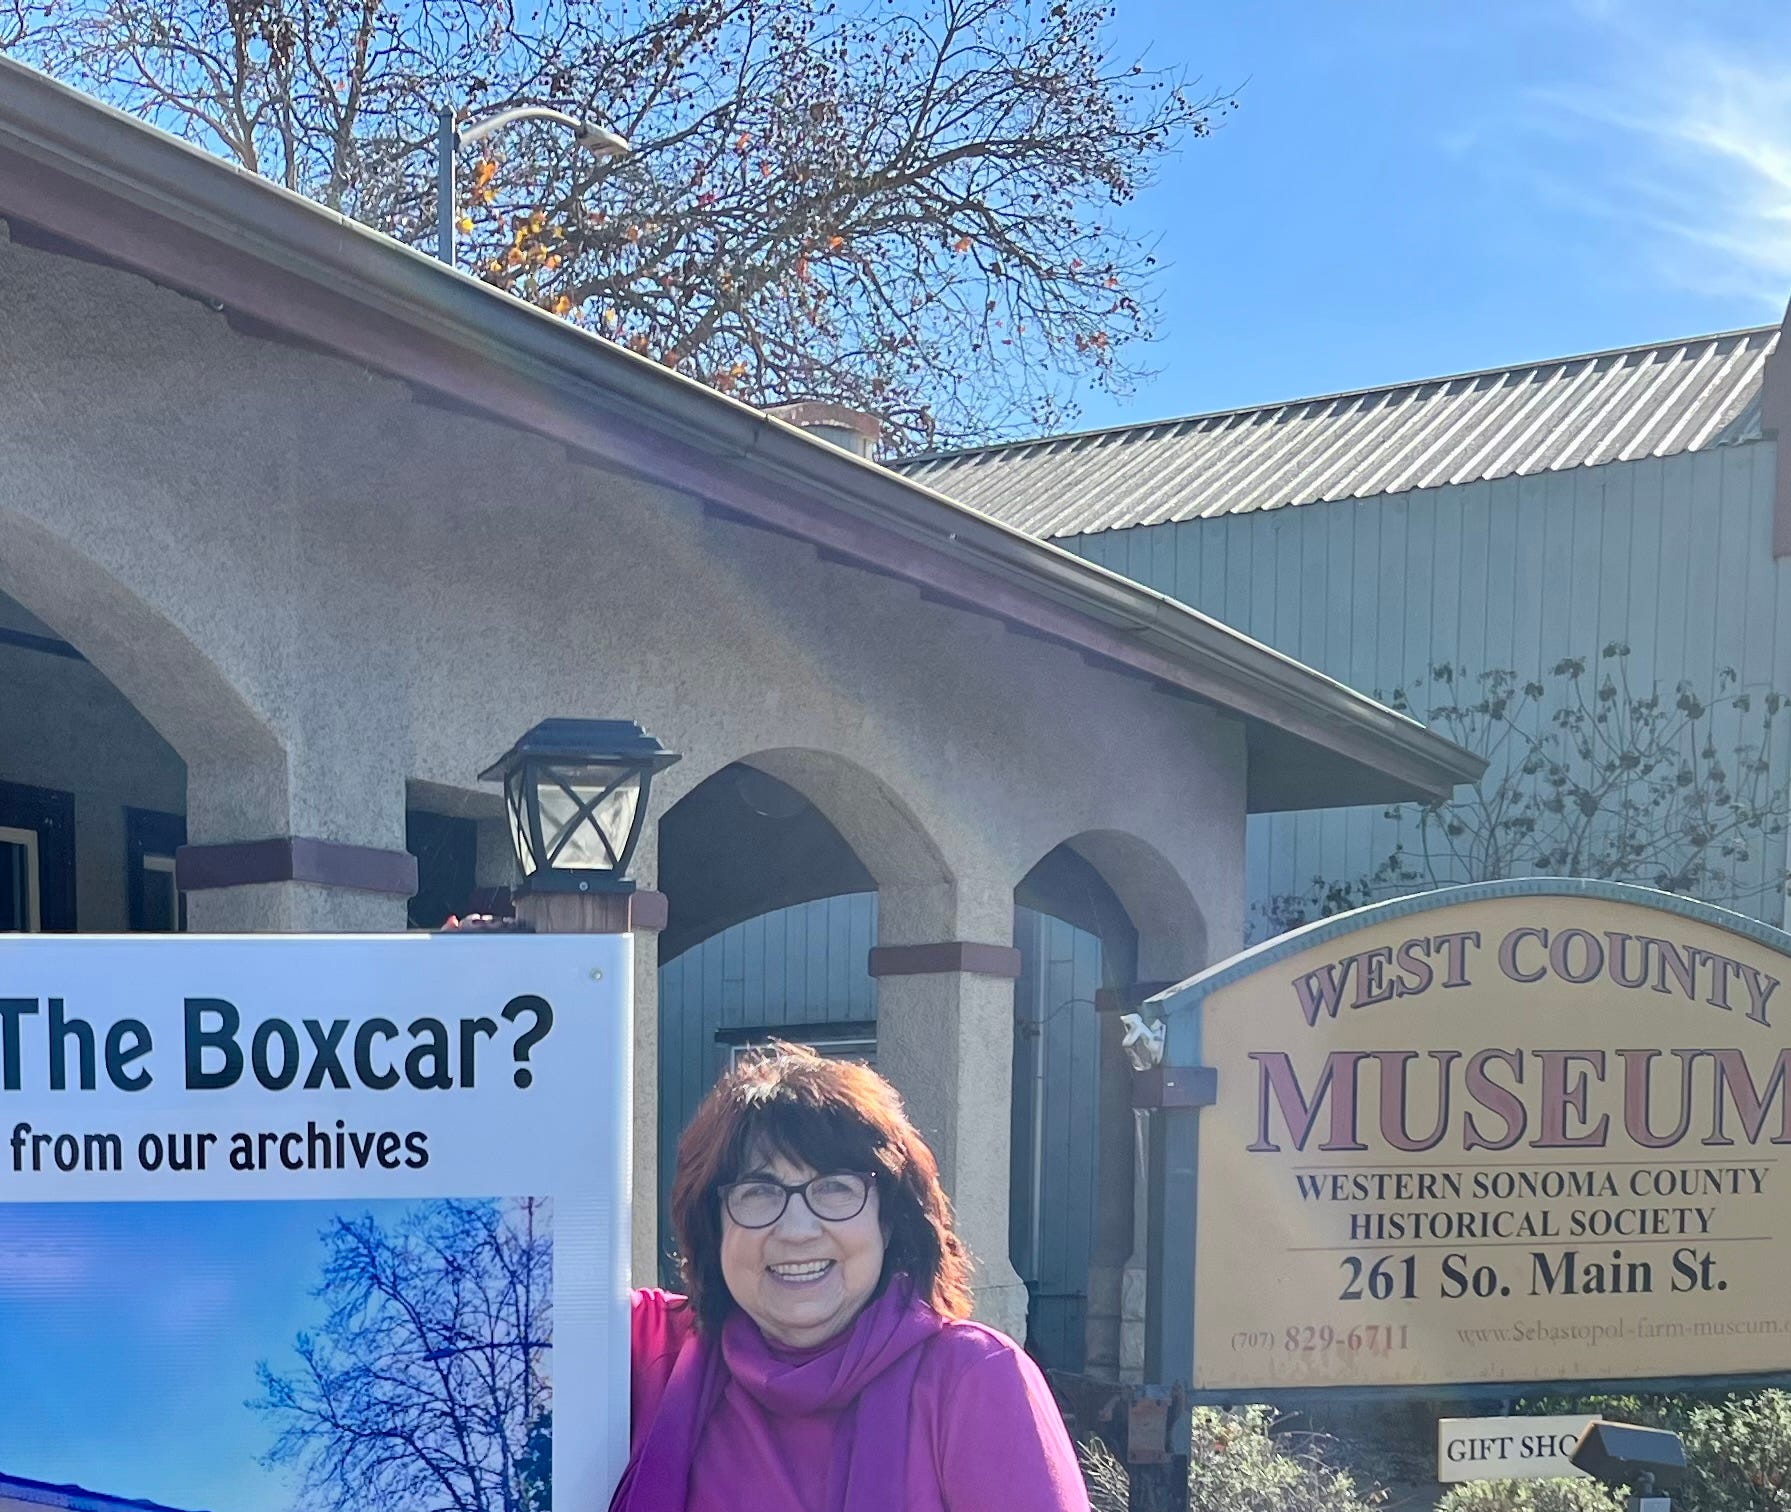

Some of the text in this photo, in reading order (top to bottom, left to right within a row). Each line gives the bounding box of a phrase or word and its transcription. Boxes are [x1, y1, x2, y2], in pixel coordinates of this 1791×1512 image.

[1291, 927, 1781, 1028] WEST COUNTY
[184, 994, 553, 1092] Boxcar?
[1246, 1046, 1791, 1153] MUSEUM
[10, 1122, 123, 1172] from
[139, 1133, 218, 1172] our
[230, 1119, 429, 1171] archives
[1295, 1167, 1770, 1202] WESTERN SONOMA COUNTY
[1348, 1207, 1717, 1241] HISTORICAL SOCIETY
[1338, 1247, 1728, 1301] 261 So. Main St.
[1231, 1323, 1409, 1351] (707) 829-6711
[1447, 1436, 1514, 1462] GIFT
